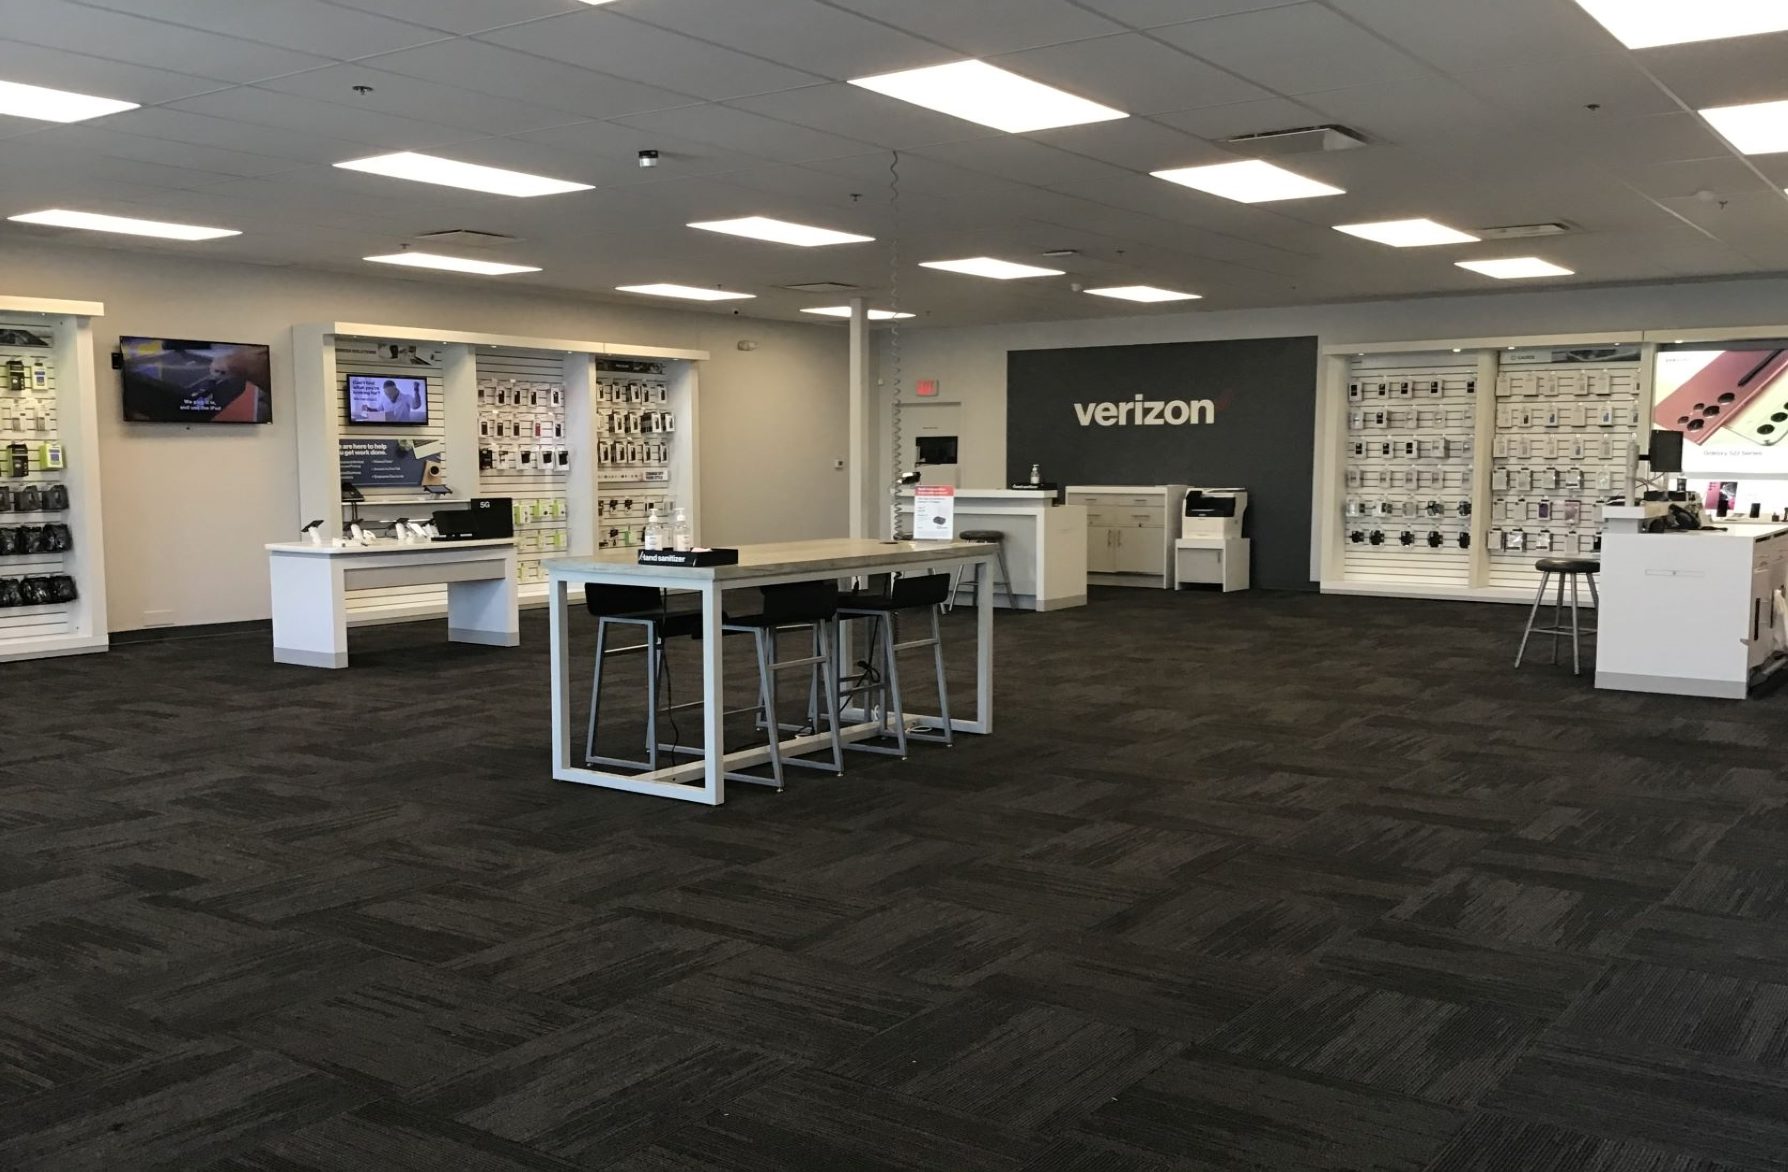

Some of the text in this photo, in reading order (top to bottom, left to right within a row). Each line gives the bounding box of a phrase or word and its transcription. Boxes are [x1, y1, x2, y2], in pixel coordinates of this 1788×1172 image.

[1073, 393, 1215, 427] verizon
[374, 443, 388, 451] help
[479, 501, 491, 509] 5G
[657, 554, 687, 563] sanitizer
